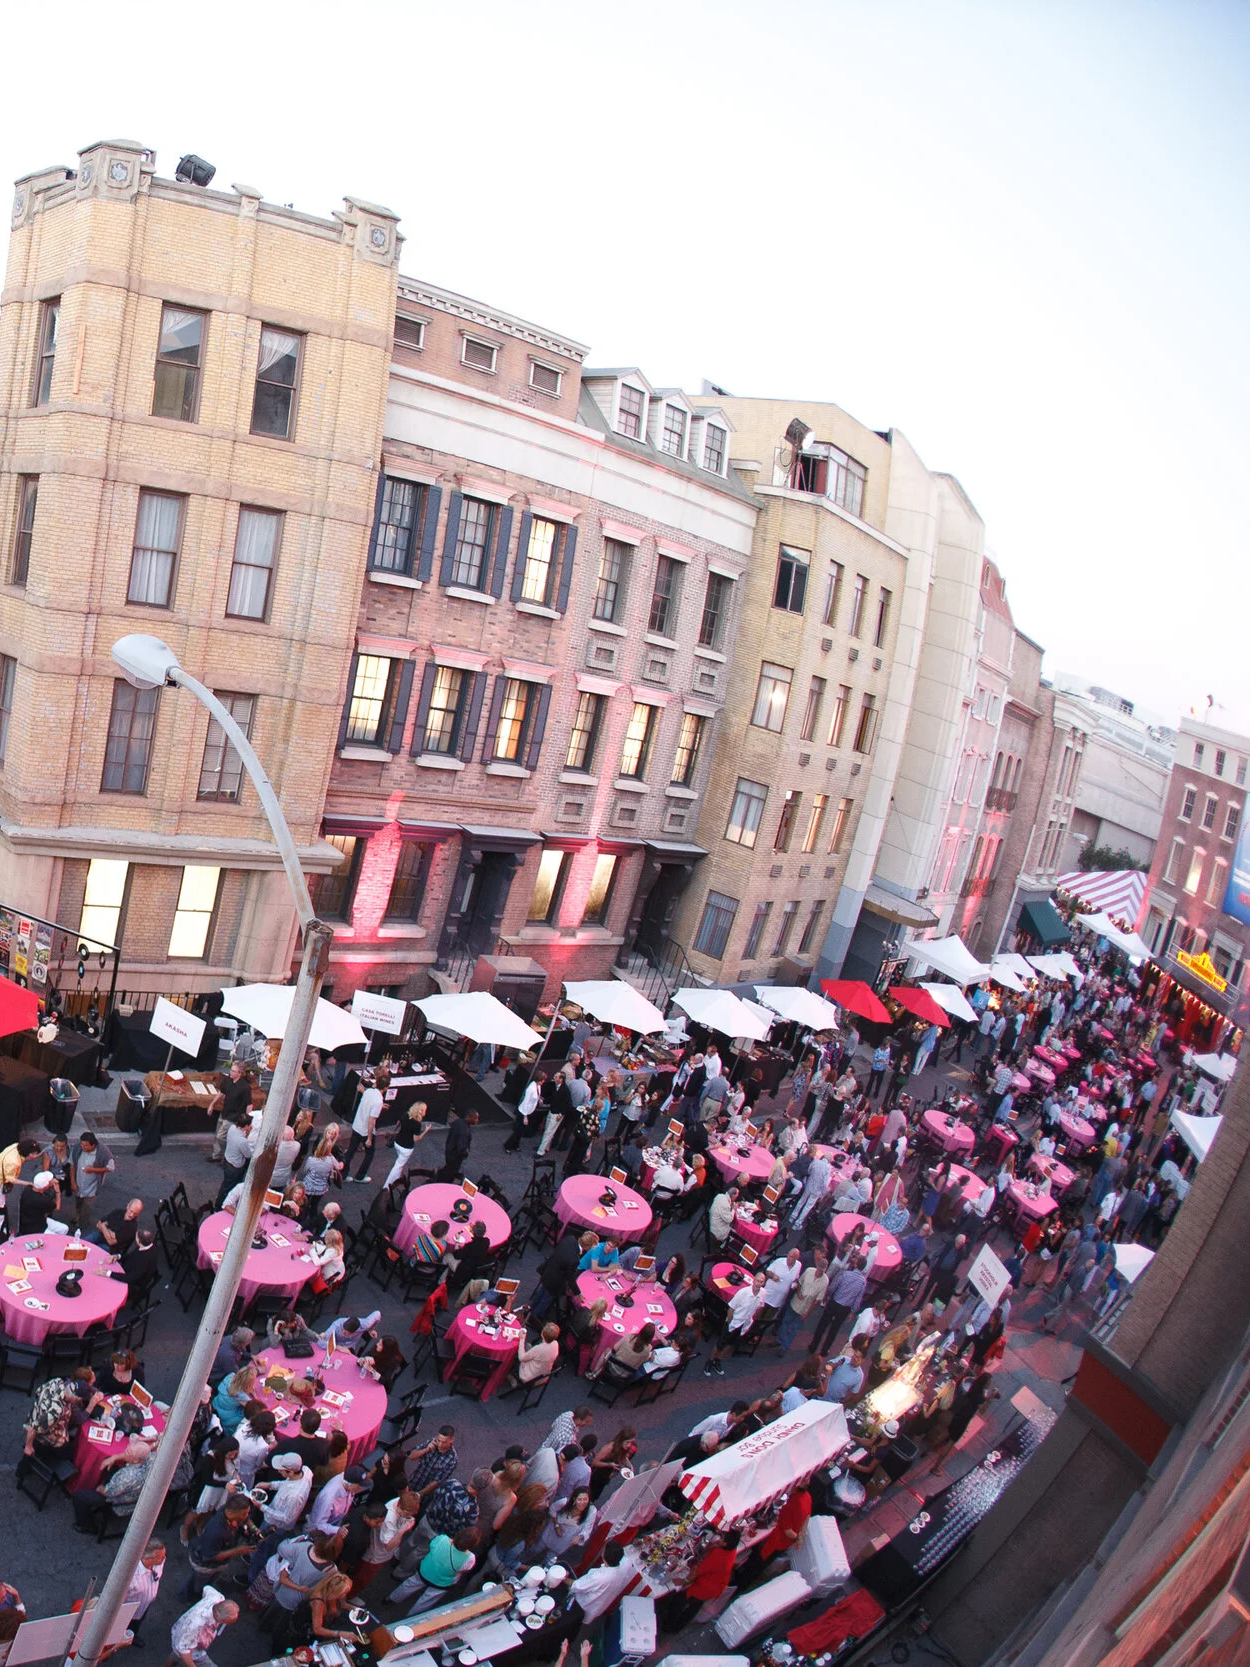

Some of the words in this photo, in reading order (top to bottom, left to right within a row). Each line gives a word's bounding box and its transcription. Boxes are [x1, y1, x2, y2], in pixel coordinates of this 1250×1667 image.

[360, 1013, 379, 1021] ITALIAN
[165, 1022, 188, 1037] AKASHA
[773, 1422, 806, 1439] DANDY
